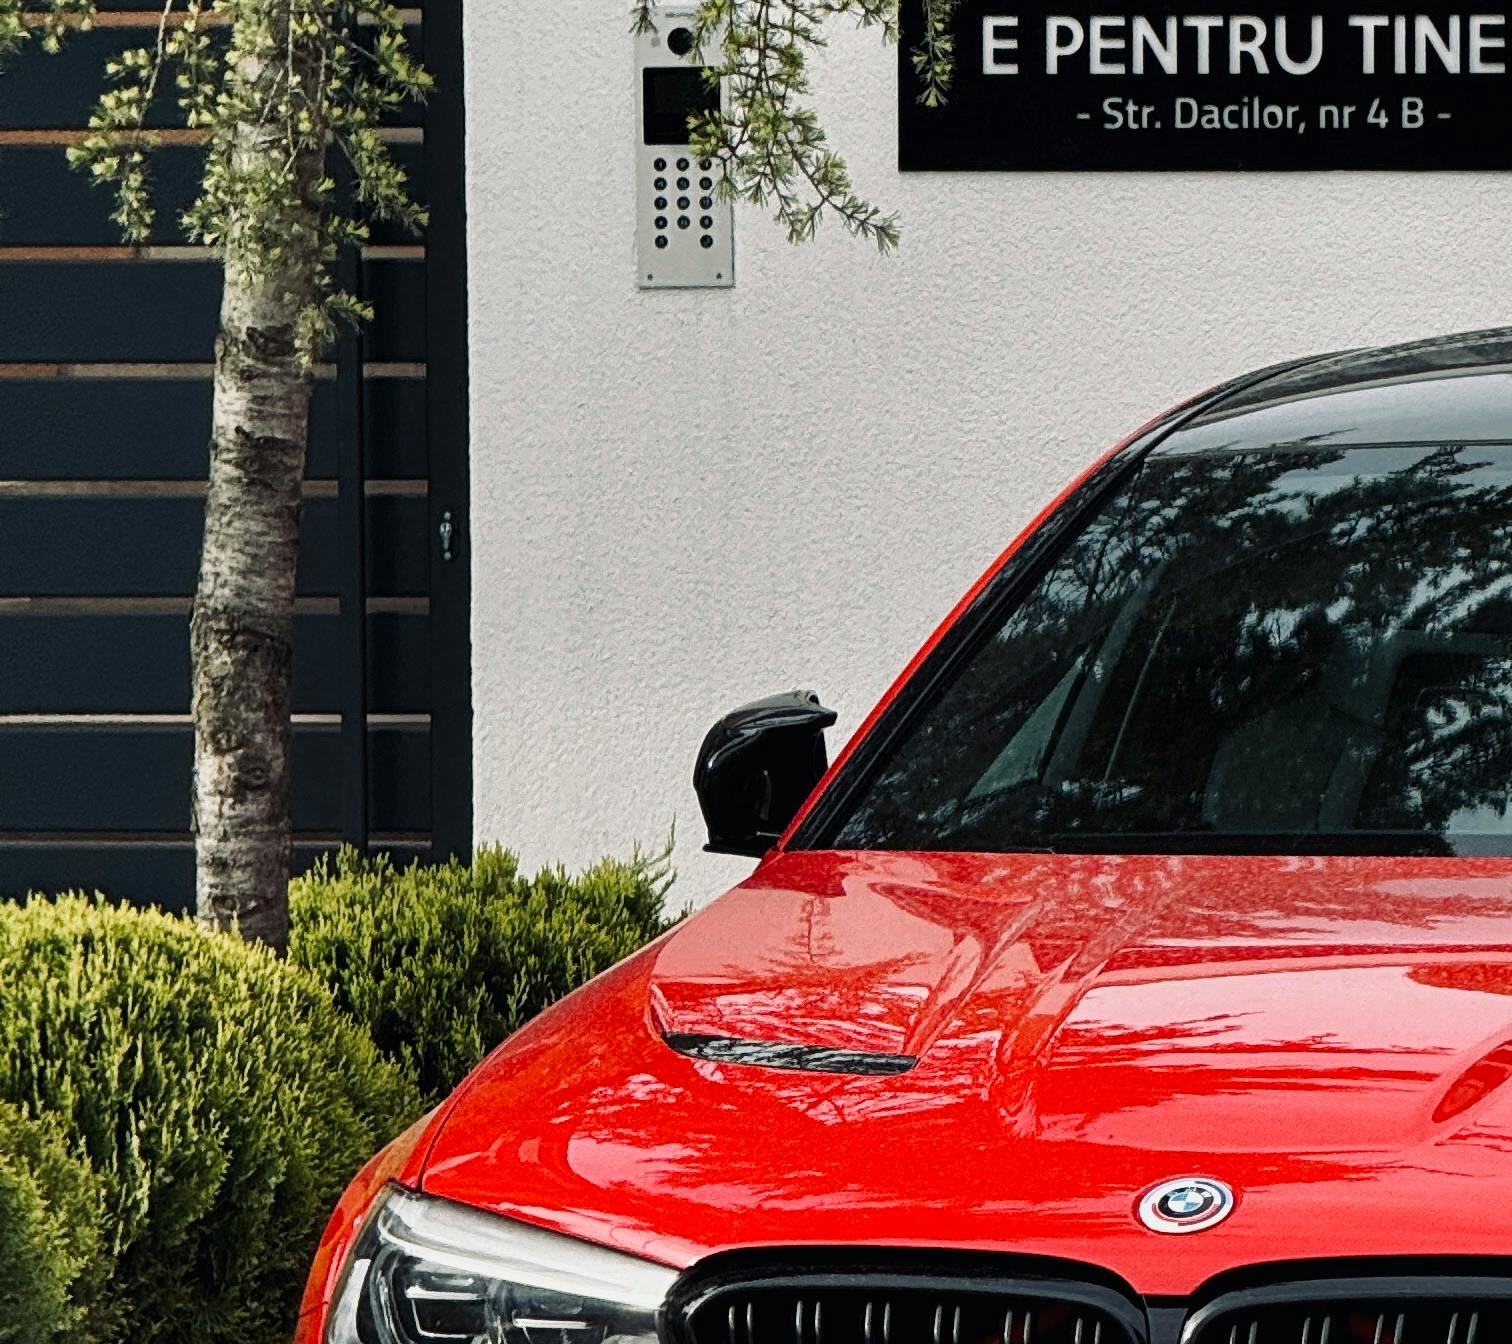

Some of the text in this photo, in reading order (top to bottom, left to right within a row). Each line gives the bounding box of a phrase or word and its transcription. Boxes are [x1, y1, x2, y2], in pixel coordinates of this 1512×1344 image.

[982, 15, 1019, 75] E
[1045, 15, 1323, 75] PENTRU
[1348, 14, 1507, 75] TINE
[1102, 96, 1162, 130] Str.
[1174, 96, 1307, 134] Dacilor,
[1319, 104, 1356, 130] nr
[1366, 97, 1389, 130] 4
[1401, 96, 1425, 130] B
